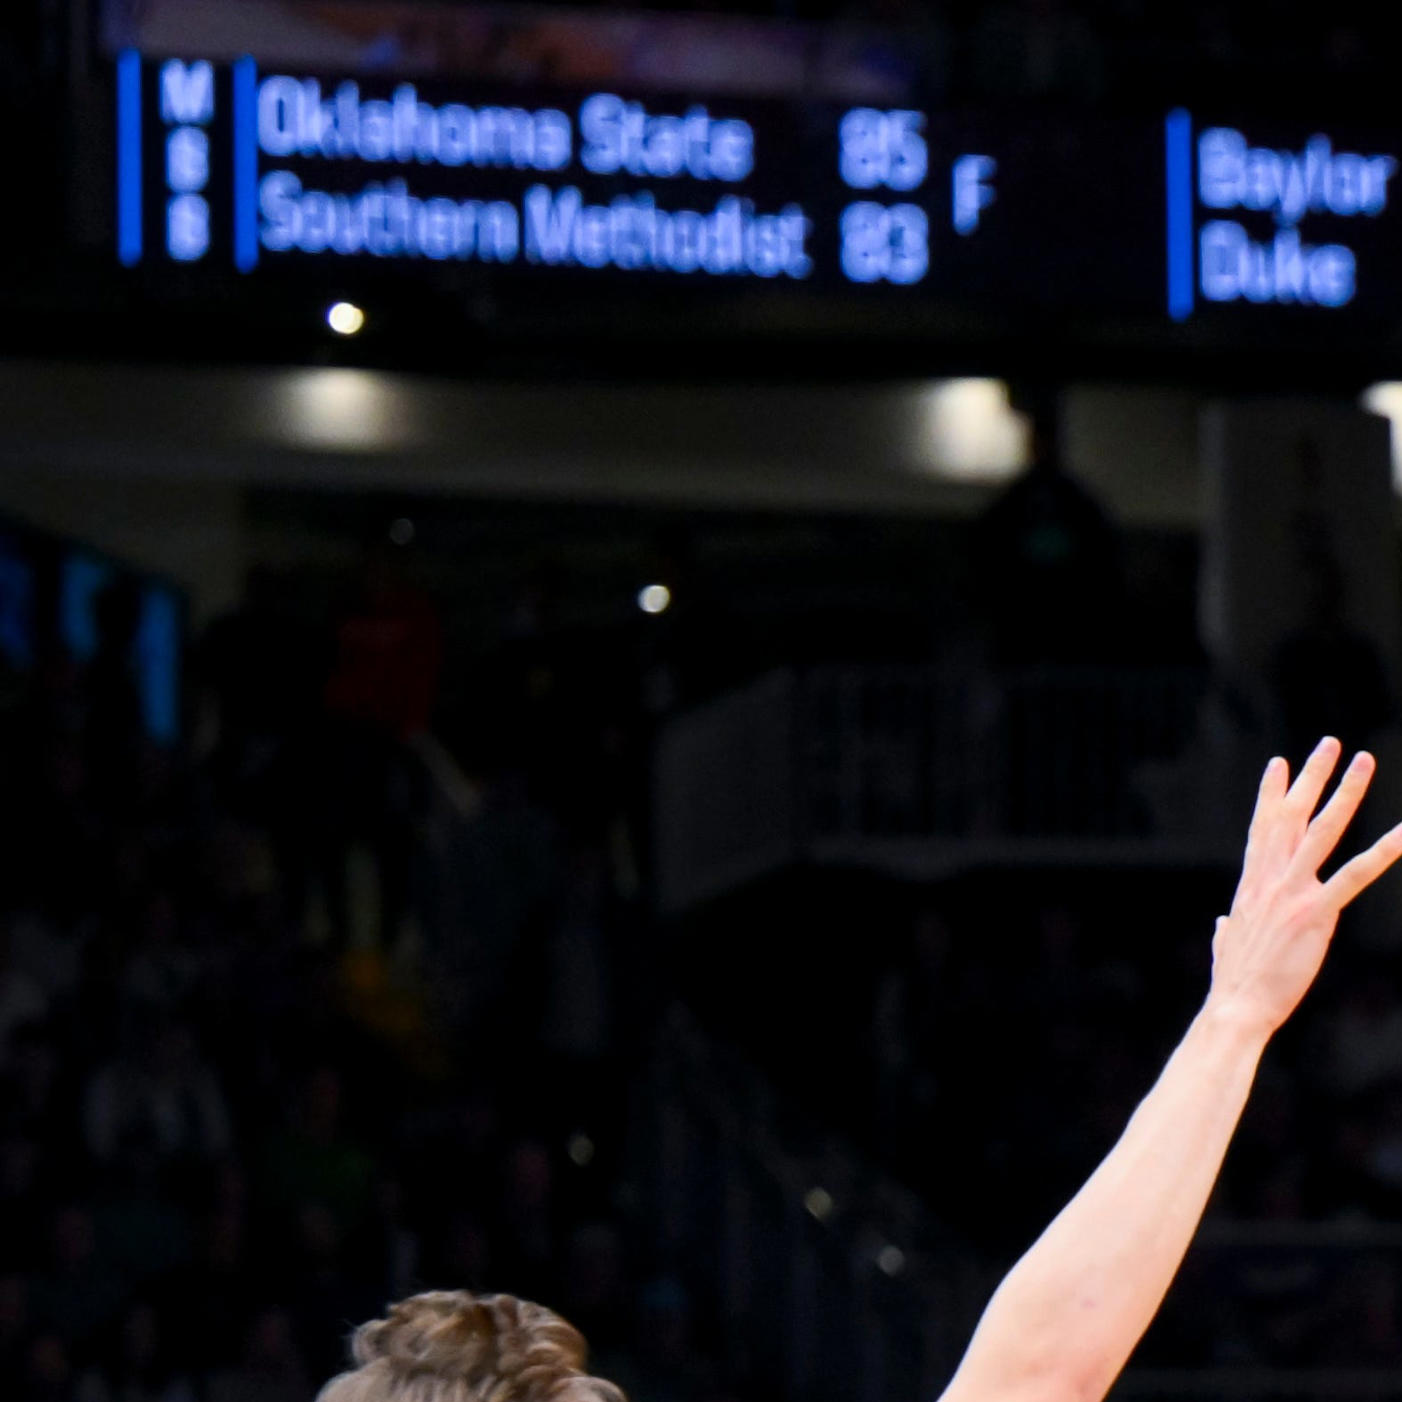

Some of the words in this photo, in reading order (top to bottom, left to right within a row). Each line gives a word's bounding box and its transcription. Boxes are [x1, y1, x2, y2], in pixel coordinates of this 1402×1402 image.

[257, 76, 573, 171] Oklahoma
[580, 93, 755, 182] State
[1199, 127, 1397, 226] Baylor
[258, 169, 520, 263] Southern
[525, 183, 813, 280] Methodist
[953, 155, 992, 232] F
[1200, 220, 1356, 307] Duke
